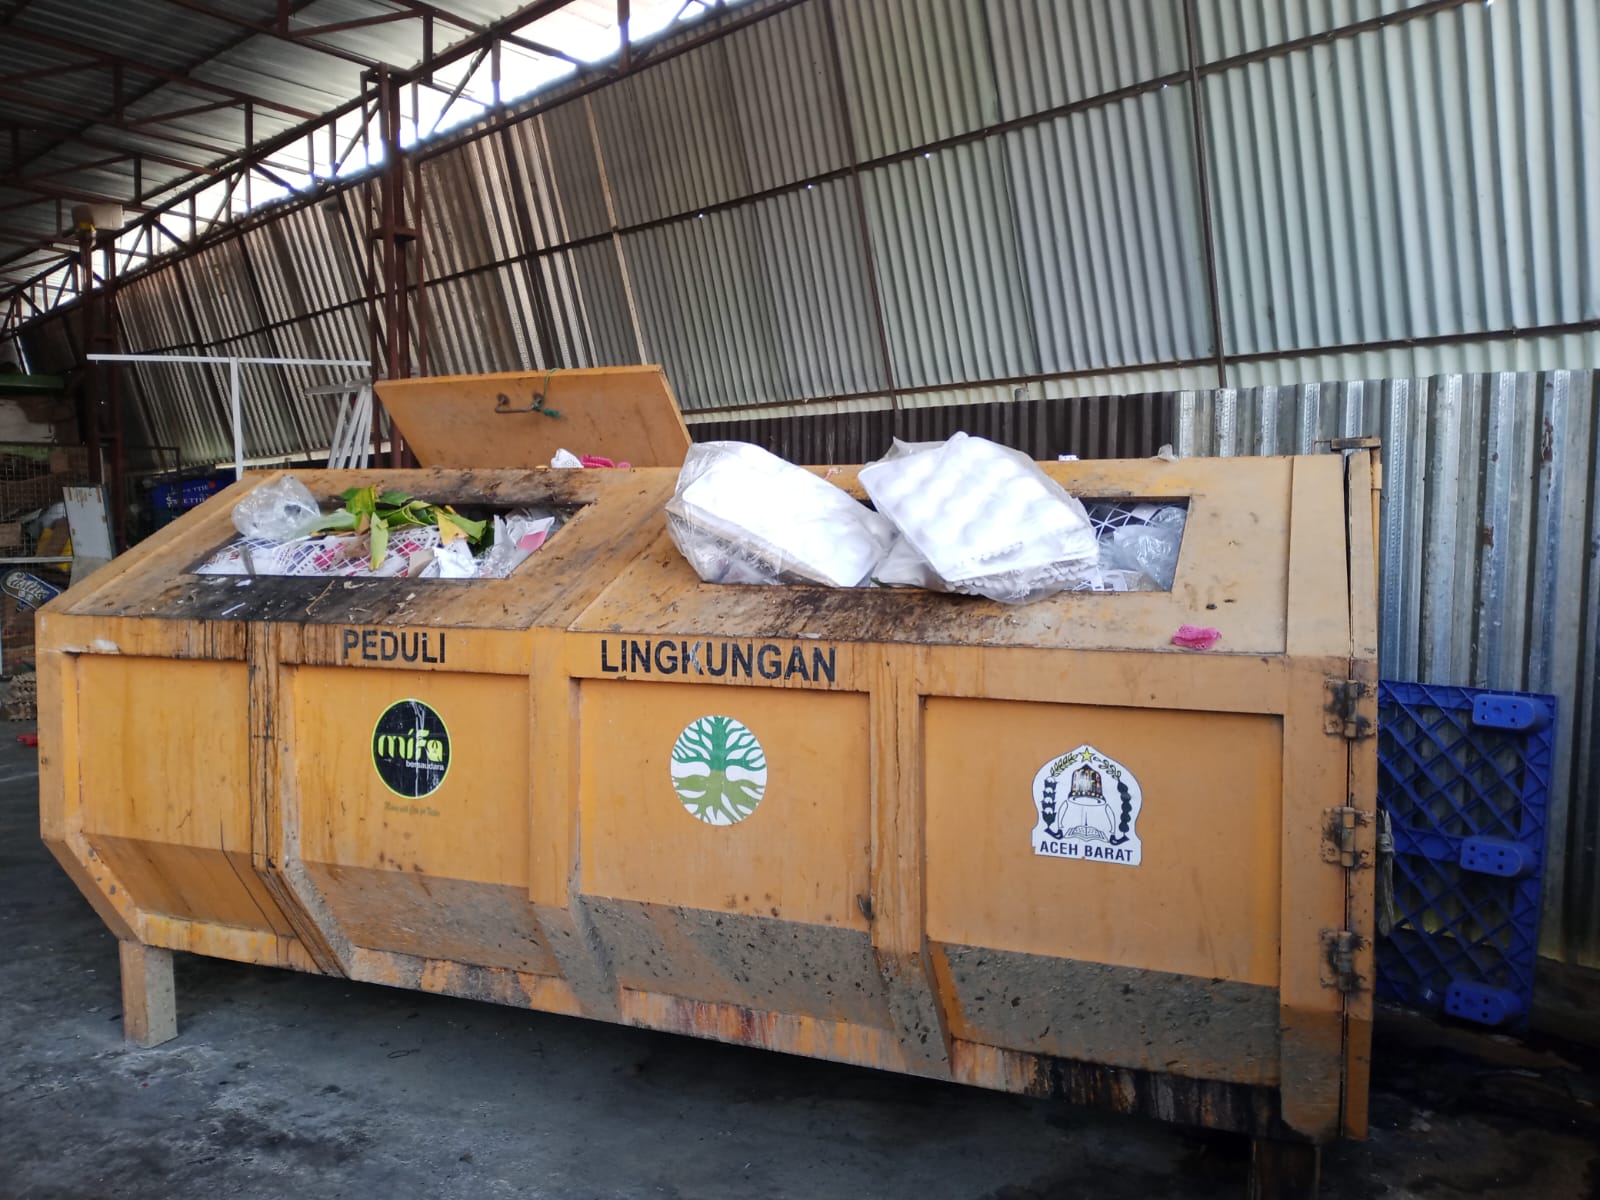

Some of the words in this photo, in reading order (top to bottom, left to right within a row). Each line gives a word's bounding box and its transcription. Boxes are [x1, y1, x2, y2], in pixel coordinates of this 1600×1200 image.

[343, 629, 445, 664] PEDULI
[601, 639, 837, 682] LINGKUNGAN
[1039, 840, 1079, 856] ACEH
[1084, 845, 1134, 862] BARAT
